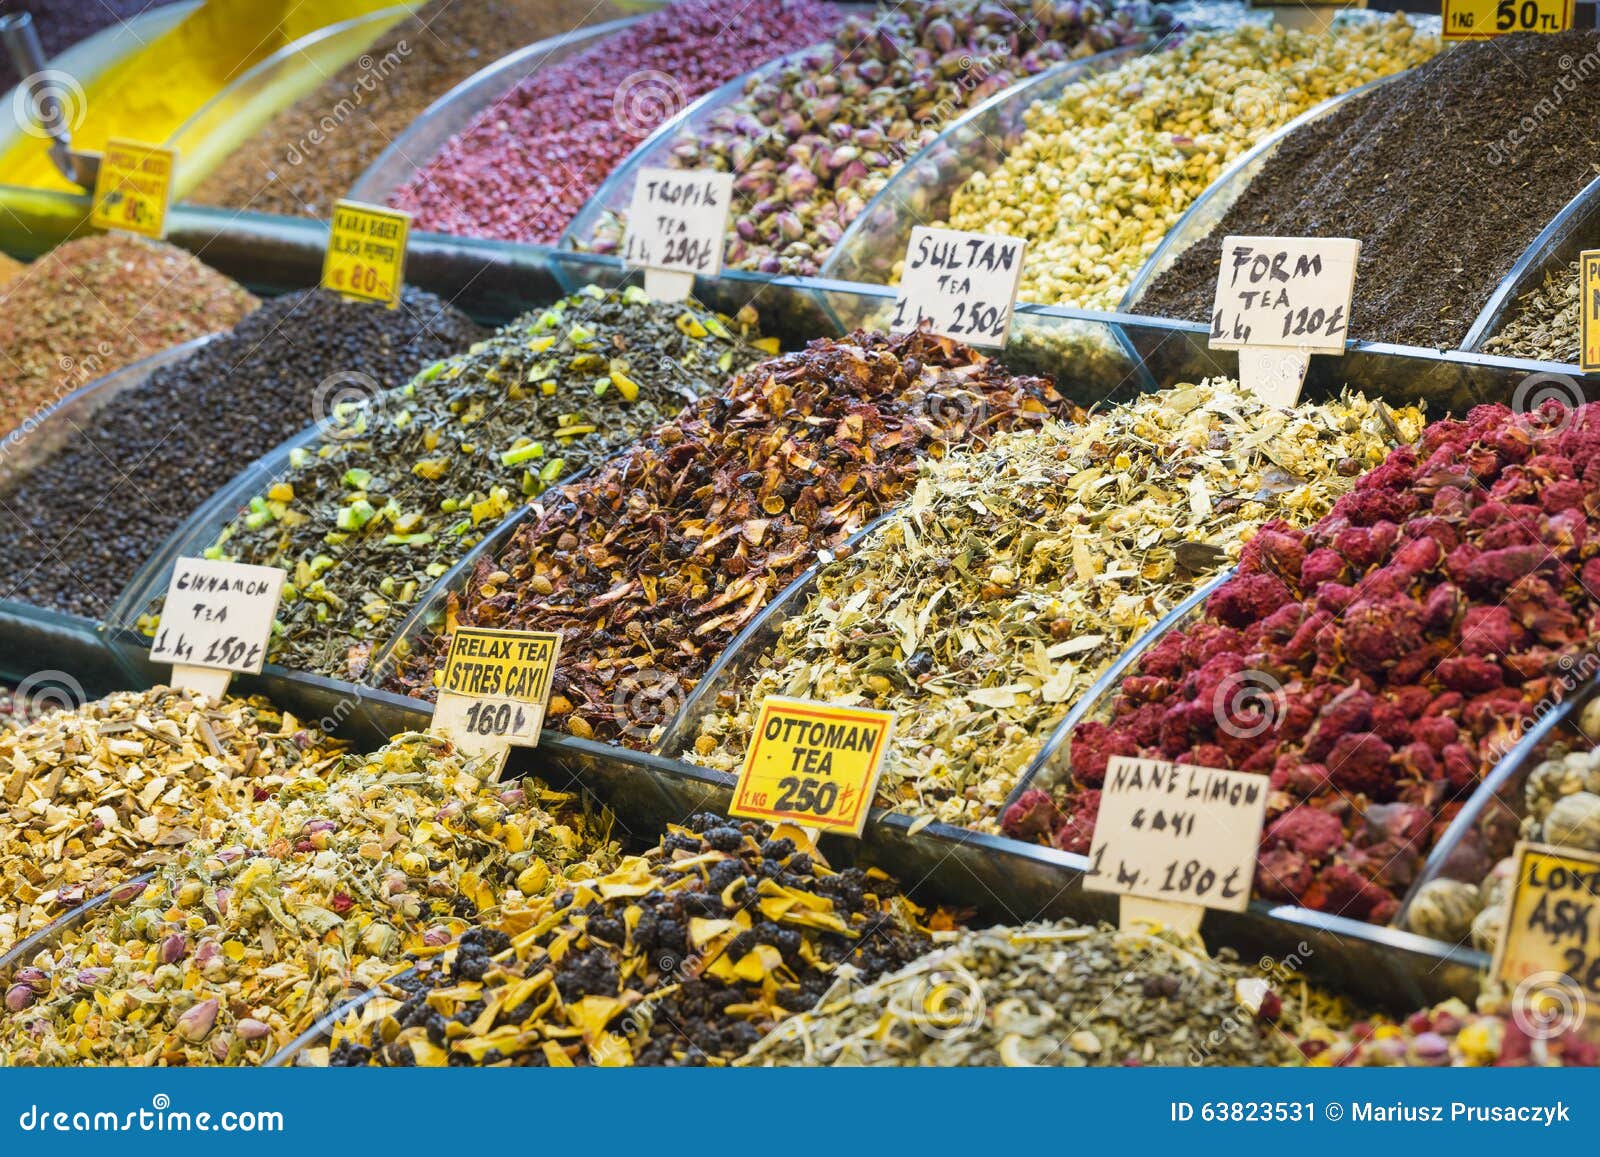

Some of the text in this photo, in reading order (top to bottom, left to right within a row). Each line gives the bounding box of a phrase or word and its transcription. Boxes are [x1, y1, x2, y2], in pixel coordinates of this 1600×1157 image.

[657, 216, 687, 236] TEA
[911, 235, 1017, 275] SULTAN
[1231, 246, 1323, 289] FORM
[936, 275, 971, 295] TEA
[1238, 288, 1290, 311] TEA
[455, 637, 549, 662] RELAX TEA
[449, 662, 544, 698] STRES CAYI
[765, 716, 878, 753] OTTOMAN
[791, 747, 833, 775] TEA
[1110, 764, 1260, 807] NANE LIMON
